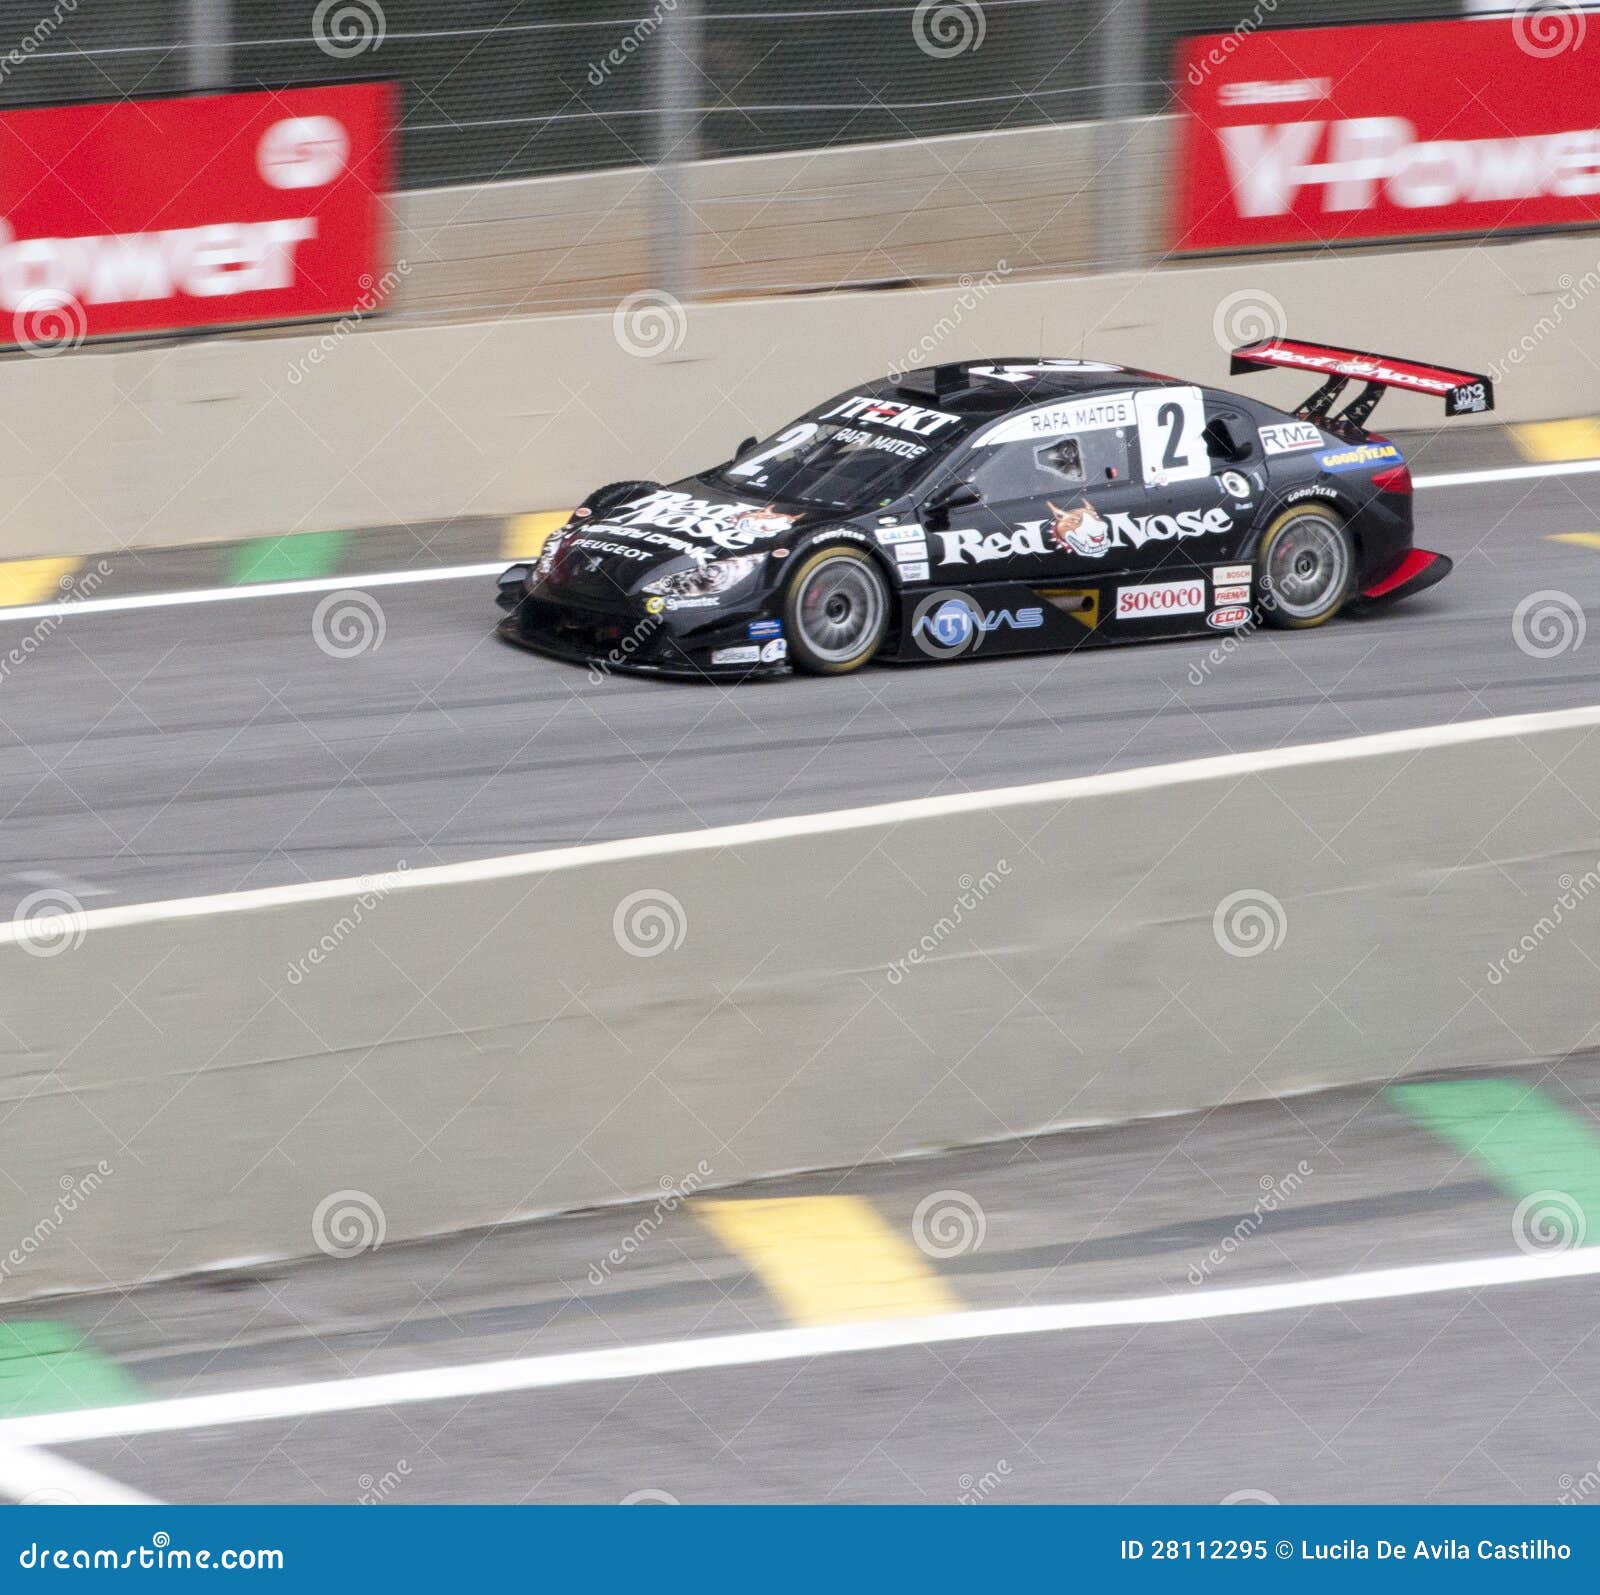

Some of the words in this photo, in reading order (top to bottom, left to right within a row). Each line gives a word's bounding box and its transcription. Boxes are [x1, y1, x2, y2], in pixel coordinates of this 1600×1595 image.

[0, 215, 318, 313] ower
[1253, 348, 1332, 368] Red
[1031, 412, 1071, 433] RAFA
[1076, 404, 1127, 429] MATOS
[831, 428, 871, 446] RAFA
[868, 436, 927, 460] MATOS
[1157, 402, 1190, 469] 2
[727, 422, 819, 477] 2
[1322, 445, 1398, 467] GOODYEAR
[1287, 485, 1338, 502] GOODYEAR
[570, 538, 653, 561] PEUGEOT
[936, 520, 1052, 566] Red
[1103, 507, 1234, 550] Nose
[1226, 570, 1250, 579] BOSCH
[1214, 608, 1246, 624] ECO
